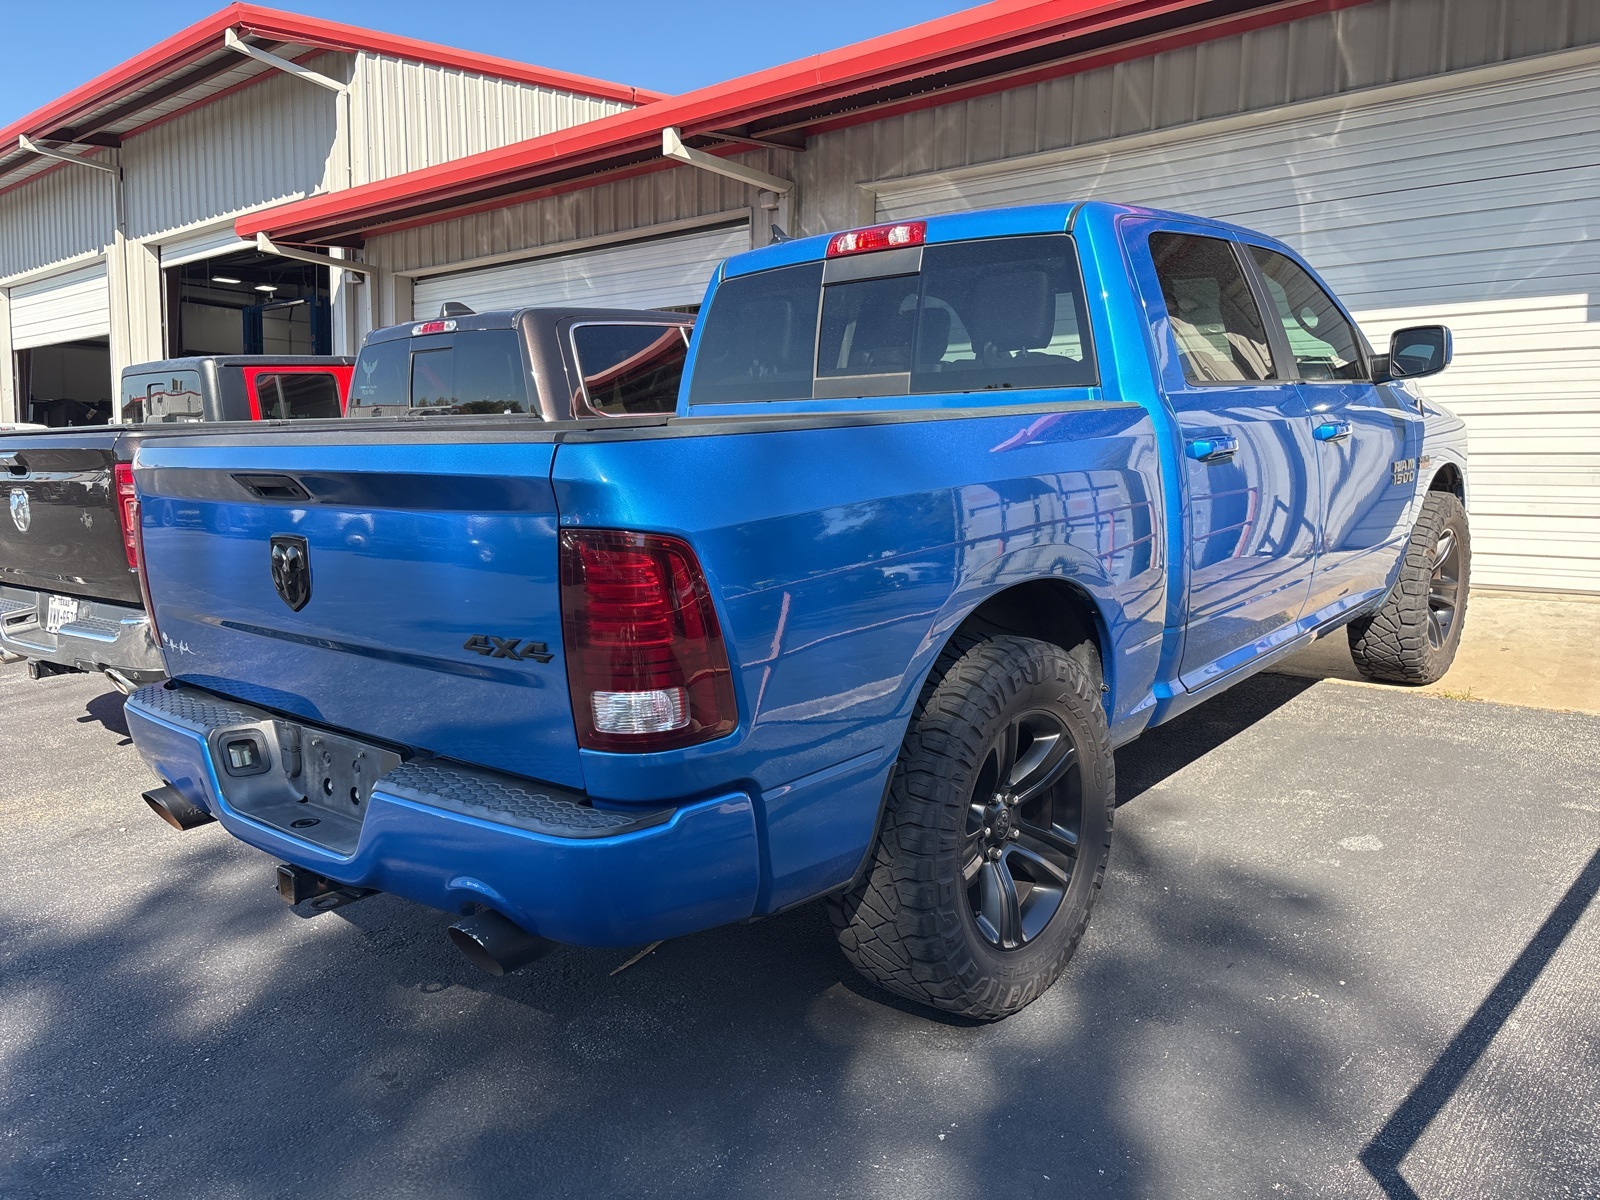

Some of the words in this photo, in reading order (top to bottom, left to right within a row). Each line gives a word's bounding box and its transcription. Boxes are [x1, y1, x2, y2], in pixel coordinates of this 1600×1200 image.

[1392, 458, 1415, 473] RAM
[1392, 470, 1414, 486] 1500
[463, 633, 555, 664] 4X4
